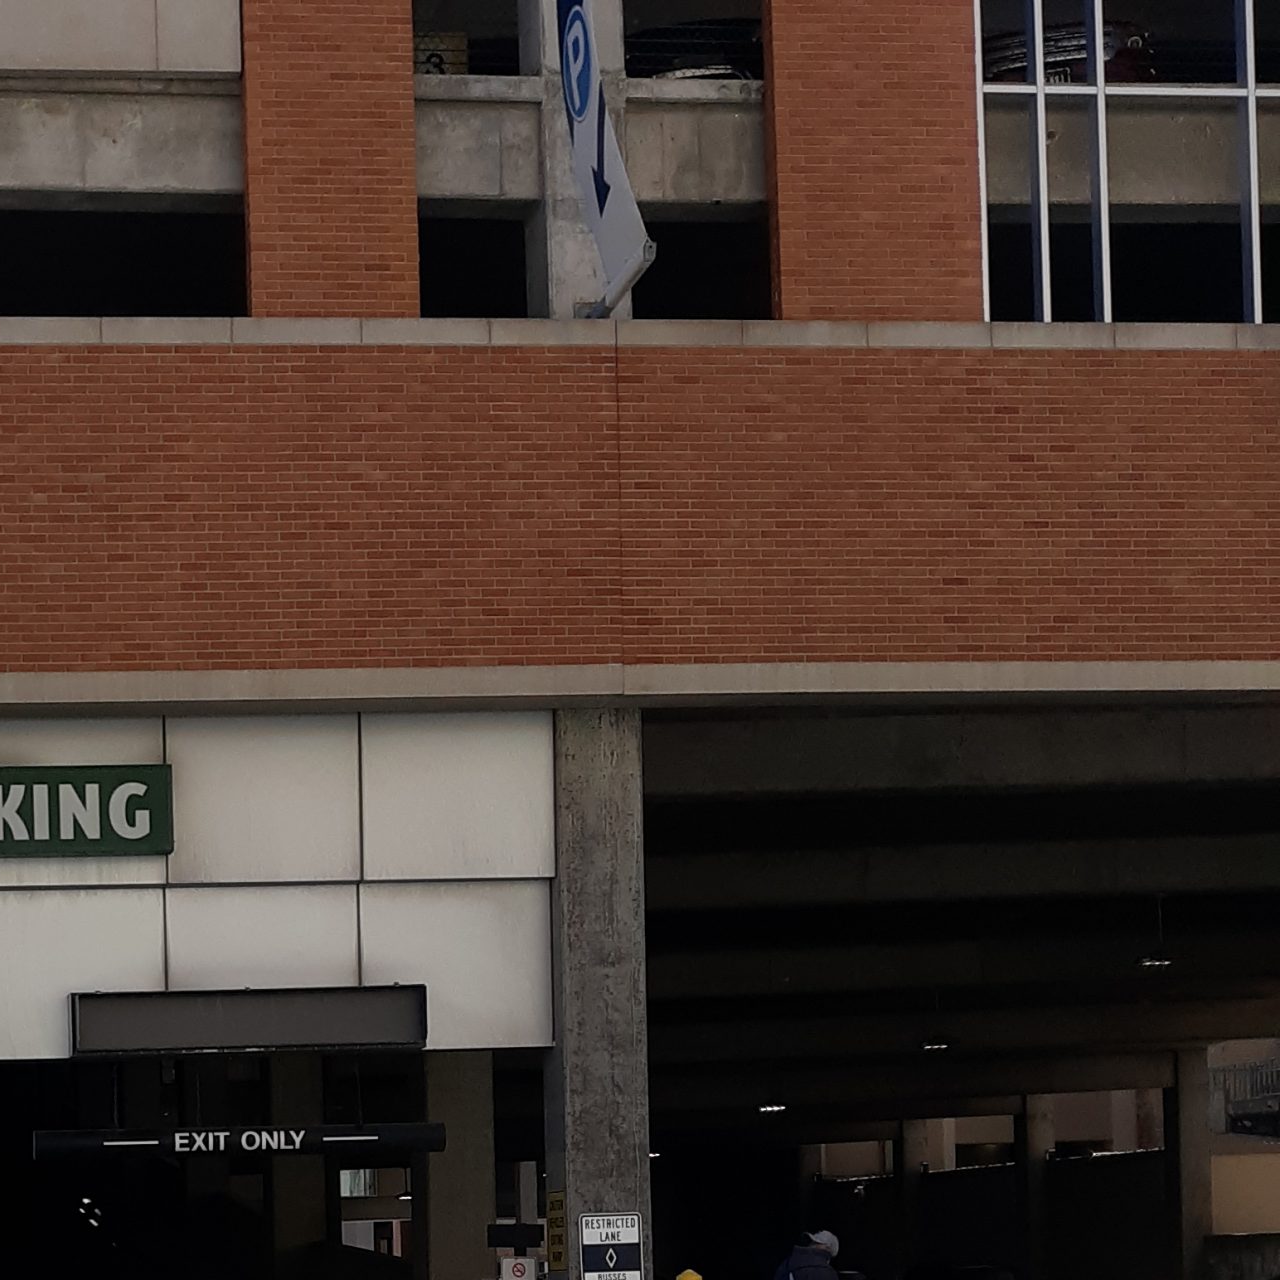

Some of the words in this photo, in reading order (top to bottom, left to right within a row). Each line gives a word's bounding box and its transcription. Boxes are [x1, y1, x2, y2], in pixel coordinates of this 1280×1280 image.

[174, 1131, 231, 1152] EXIT
[240, 1130, 306, 1151] ONLY
[584, 1218, 637, 1230] RESTRICTED
[599, 1231, 622, 1243] LANE
